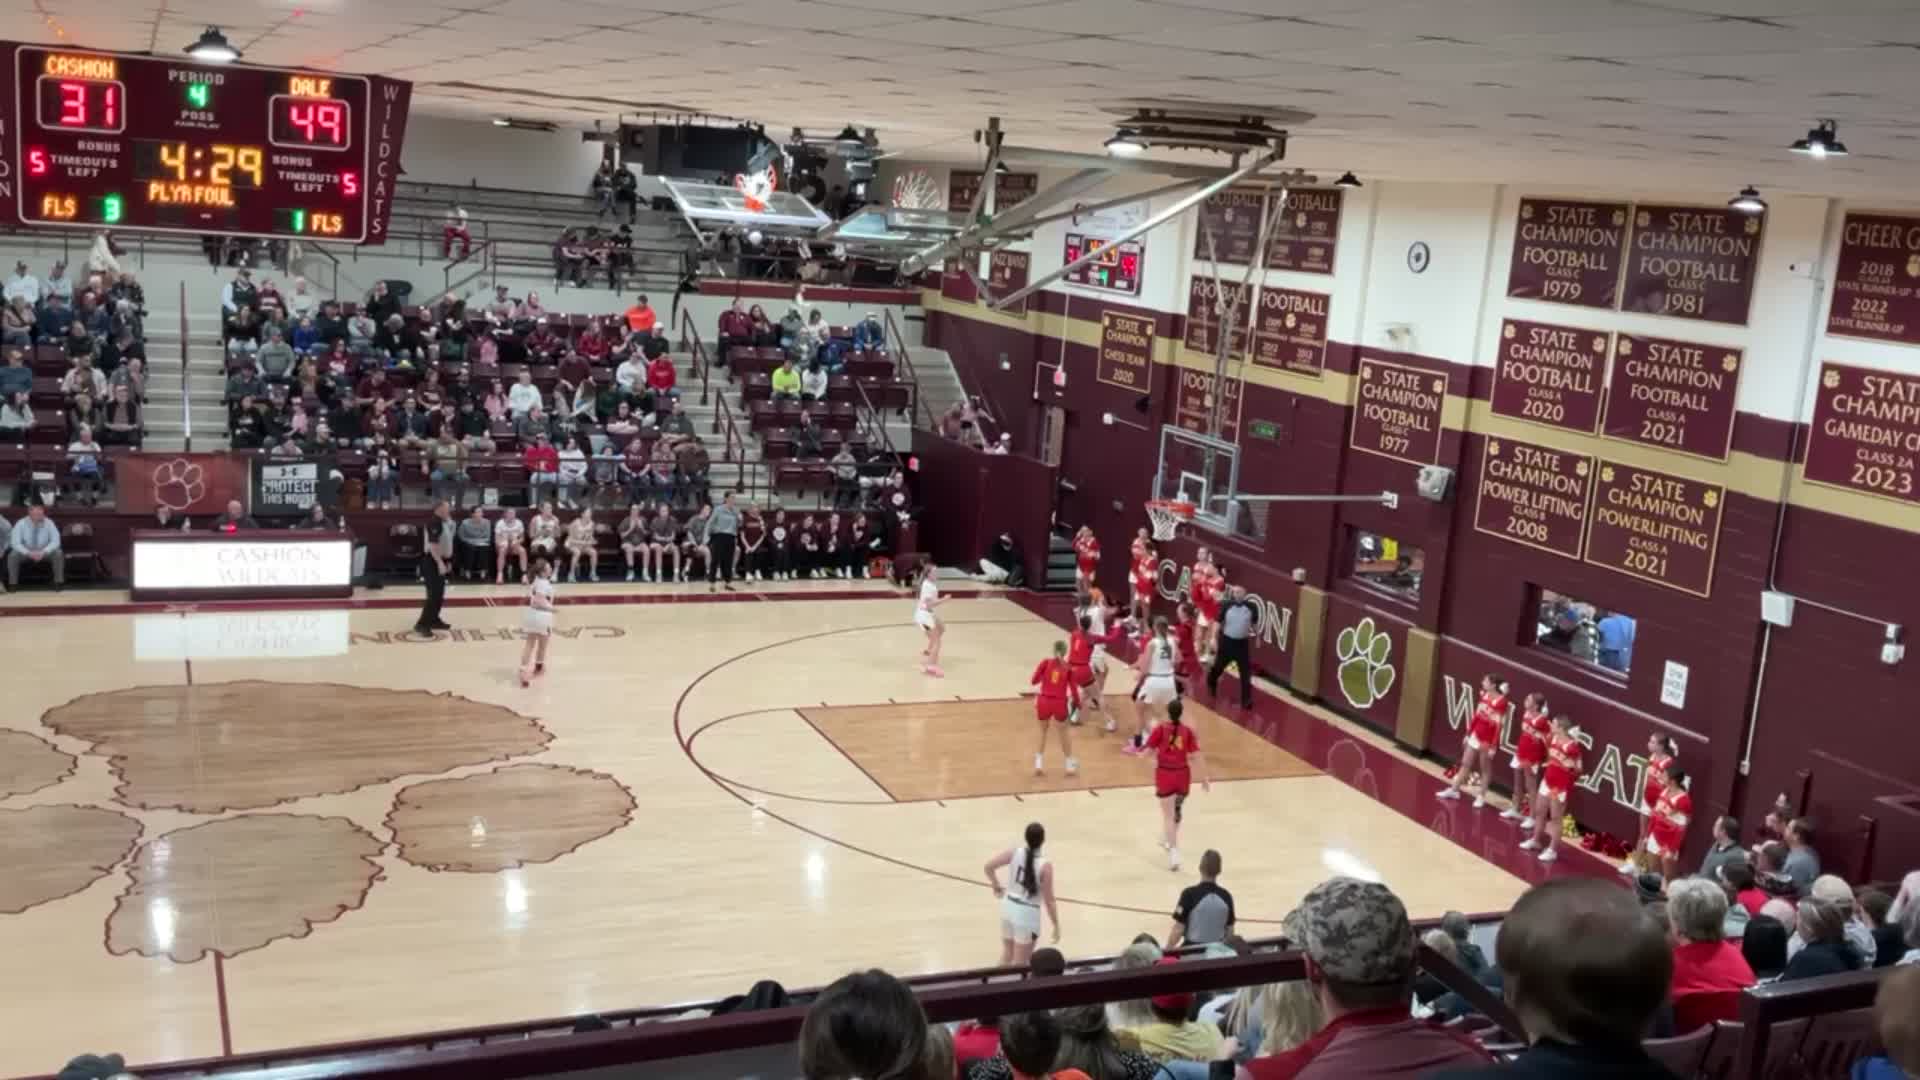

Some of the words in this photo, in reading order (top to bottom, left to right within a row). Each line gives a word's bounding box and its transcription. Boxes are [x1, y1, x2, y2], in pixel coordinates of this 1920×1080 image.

[46, 55, 115, 78] CASHION
[168, 69, 225, 86] PERIOD
[188, 84, 207, 107] 4
[290, 77, 331, 97] DALE
[60, 83, 114, 126] 31
[181, 110, 214, 121] POSS
[291, 106, 341, 143] 49
[77, 140, 120, 152] BONUS
[30, 151, 46, 173] 5
[50, 154, 118, 169] TIMEOUTS
[161, 144, 263, 187] 4:29
[272, 155, 312, 167] BONUS
[371, 85, 400, 234] WILDCATS
[67, 167, 100, 177] LEFT
[278, 170, 340, 184] TIMEOUTS
[149, 181, 192, 205] PLYR
[194, 185, 235, 206] FOUL
[294, 183, 324, 193] LEFT
[343, 174, 357, 195] 5
[43, 195, 76, 217] FLS
[104, 197, 120, 222] 3
[1548, 206, 1596, 225] STATE
[293, 209, 304, 232] 1
[311, 213, 343, 233] FLS
[1668, 213, 1726, 234] STATE
[1521, 223, 1619, 247] CHAMPION
[1637, 232, 1751, 257] CHAMPION
[1845, 223, 1901, 249] CHEER
[1523, 246, 1609, 271] FOOTBALL
[1639, 256, 1740, 283] FOOTBALL
[1859, 261, 1895, 276] 2018
[1546, 266, 1573, 278] CLASS
[1542, 280, 1582, 300] 1979
[1667, 279, 1698, 290] CLASS
[1263, 291, 1326, 316] FOOTBALL
[1664, 293, 1705, 315] 1981
[1851, 297, 1888, 313] 2022
[1106, 329, 1148, 347] CHAMPION
[1116, 319, 1140, 334] STATE
[1529, 328, 1577, 349] STATE
[1510, 344, 1593, 370] CHAMPION
[1648, 344, 1704, 368] STATE
[1113, 367, 1135, 384] 2020
[1383, 369, 1421, 391] STATE
[1502, 360, 1595, 394] FOOTBALL
[1625, 360, 1723, 391] CHAMPION
[1362, 383, 1439, 411] CHAMPION
[1528, 387, 1554, 399] CLASS
[1554, 391, 1562, 401] A
[1630, 384, 1709, 412] FOOTBALL
[1364, 403, 1430, 432] FOOTBALL
[1522, 399, 1564, 422] 2020
[1646, 408, 1676, 422] CLASS
[1677, 412, 1686, 424] A
[1380, 434, 1409, 454] 1977
[1640, 421, 1685, 446] 2021
[1824, 418, 1903, 447] GAMEDAY
[1514, 447, 1561, 472] STATE
[1856, 448, 1895, 465] CLASS
[1897, 456, 1914, 470] 2A
[262, 480, 320, 493] PROTECT
[1489, 460, 1582, 496] CHAMPION
[1631, 473, 1685, 502] STATE
[1852, 463, 1912, 493] 2023
[1483, 480, 1530, 507] POWER
[1532, 492, 1582, 521] LIFTING
[1608, 488, 1704, 525] CHAMPION
[1513, 506, 1540, 519] CLASS
[1506, 516, 1548, 543] 2008
[1598, 507, 1708, 550] POWERLIFTING
[217, 546, 321, 562] CASHION
[1629, 536, 1660, 552] CLASS
[1661, 545, 1668, 555] A
[1623, 550, 1666, 577] 2021
[1157, 558, 1293, 652] CAON
